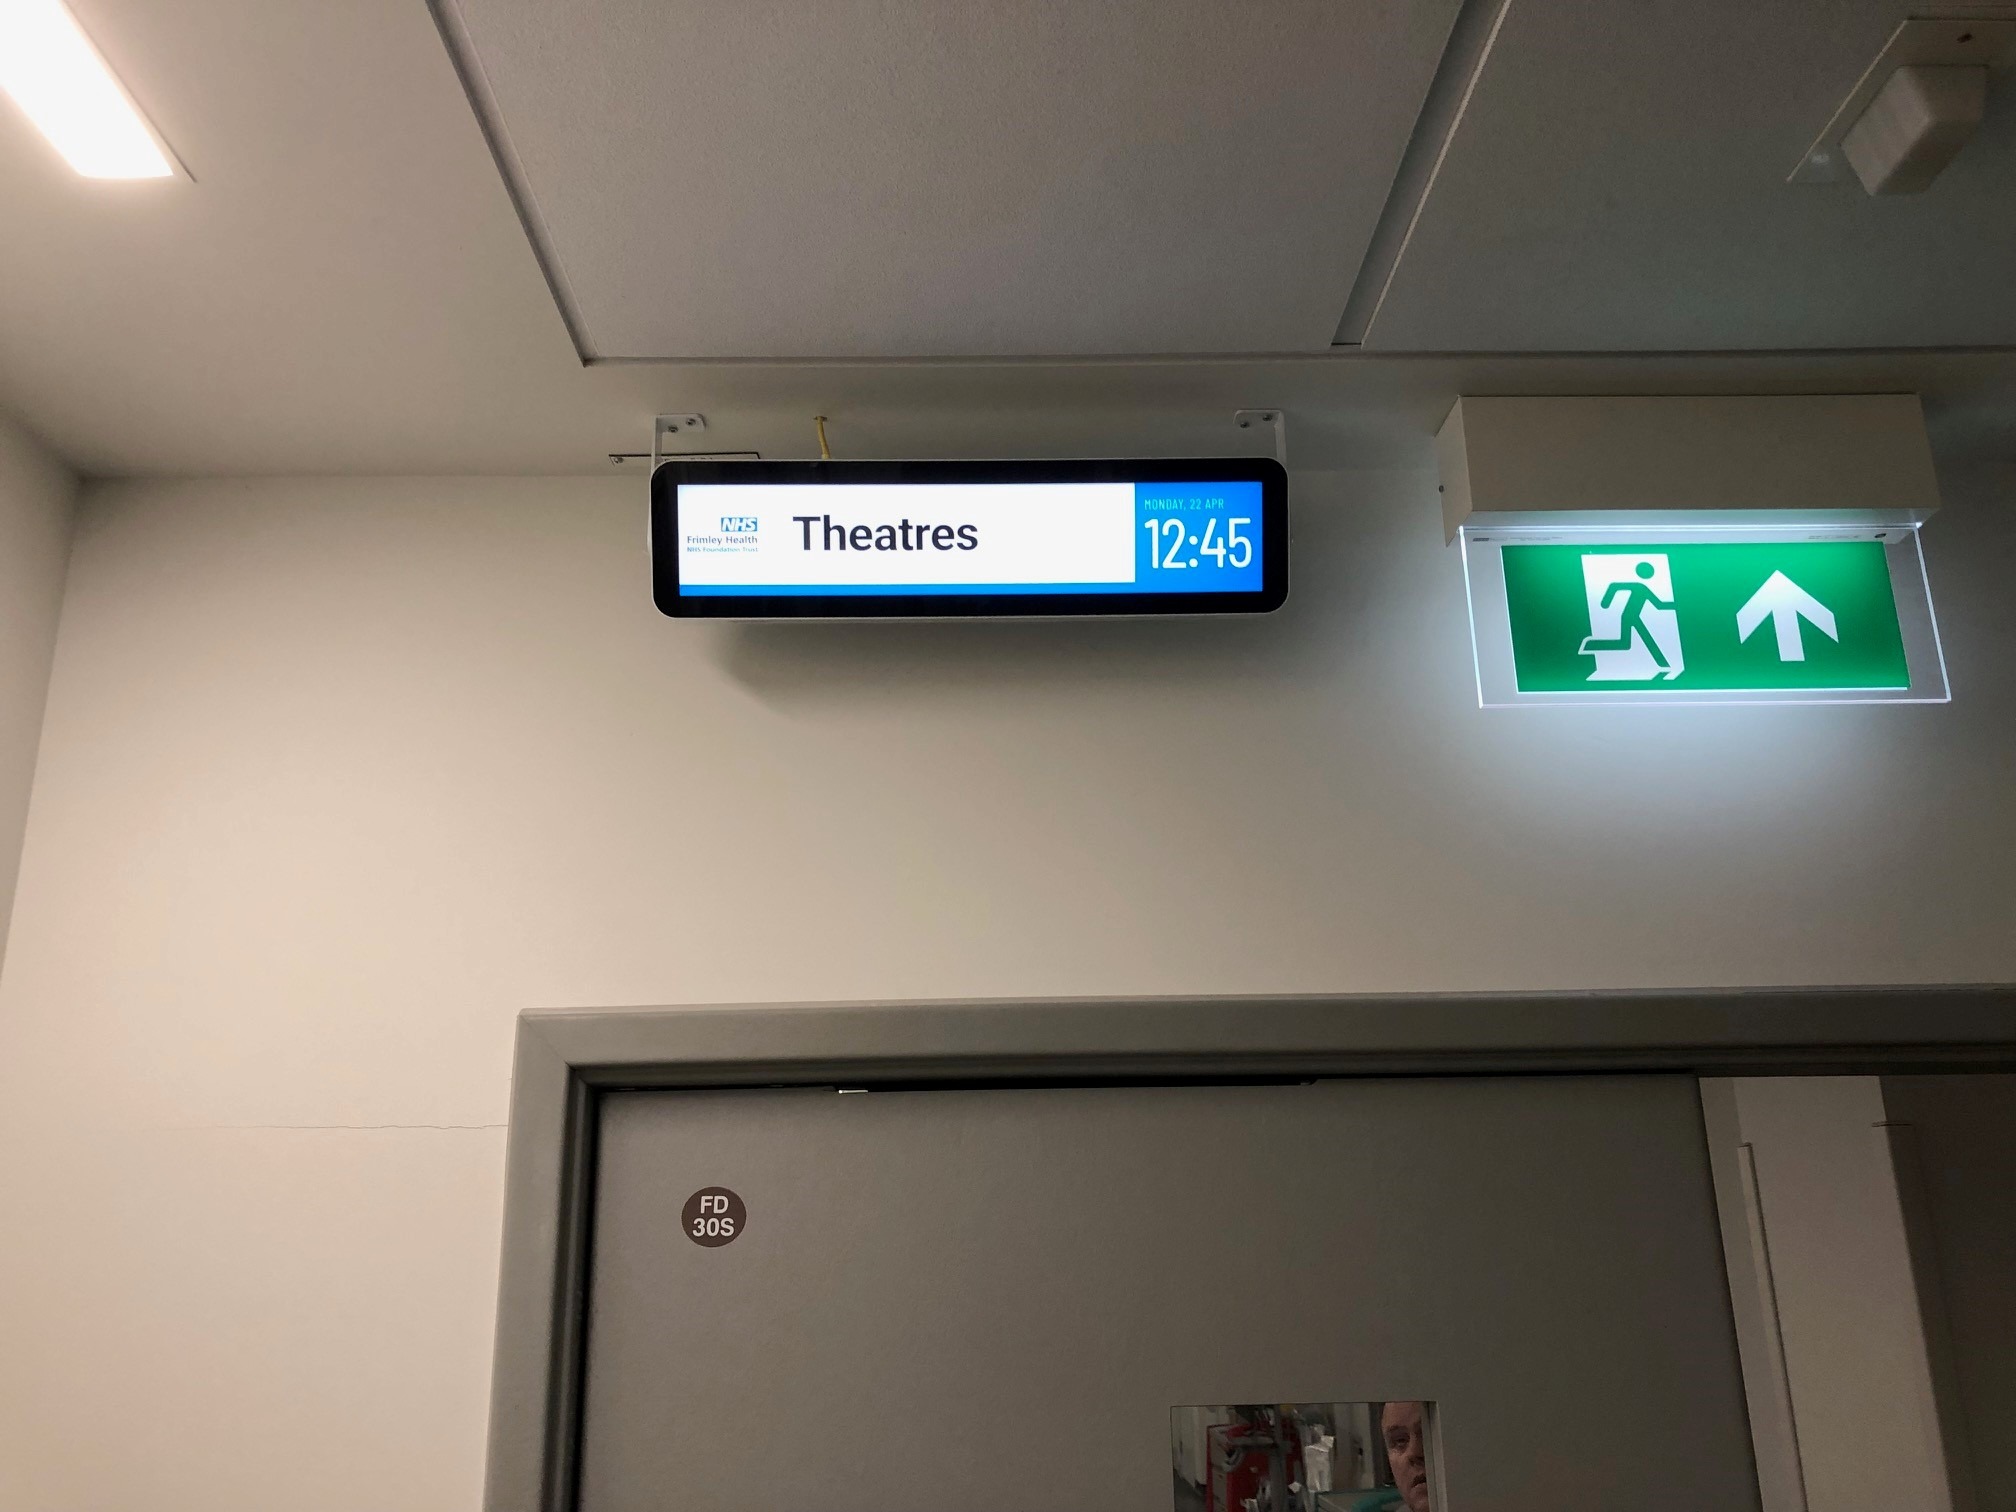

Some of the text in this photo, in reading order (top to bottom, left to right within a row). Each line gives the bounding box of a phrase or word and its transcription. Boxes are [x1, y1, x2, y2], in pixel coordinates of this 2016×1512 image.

[1144, 498, 1224, 511] MONDAY, 22 APR
[721, 517, 757, 532] NHS
[793, 514, 978, 551] Theatres
[687, 535, 758, 545] Frimley Health
[1144, 517, 1252, 569] 12:45
[700, 1195, 729, 1214] FD
[692, 1217, 735, 1237] 30S
